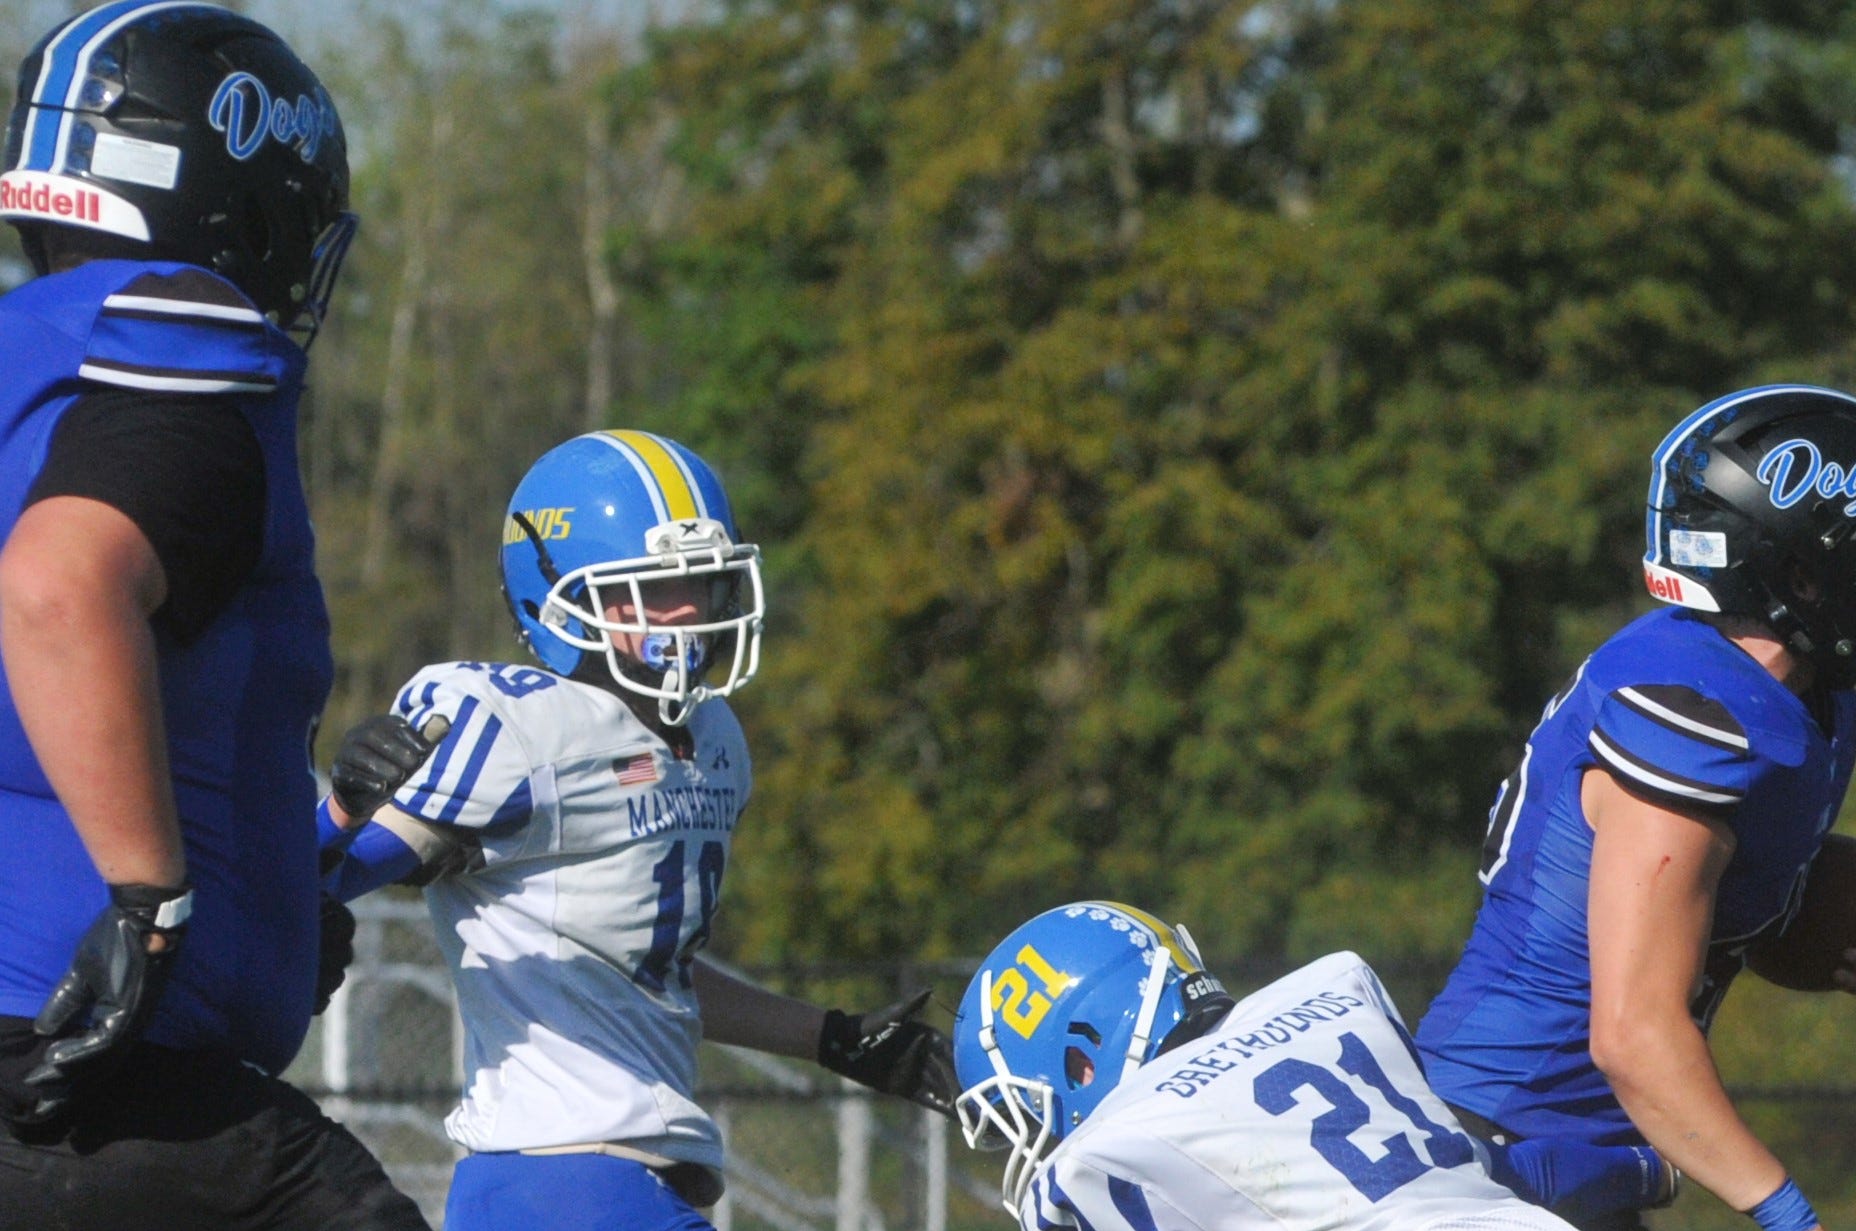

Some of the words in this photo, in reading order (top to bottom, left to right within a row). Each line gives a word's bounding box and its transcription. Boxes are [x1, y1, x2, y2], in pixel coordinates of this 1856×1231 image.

[208, 71, 336, 164] Dogs
[0, 180, 100, 223] Riddell
[990, 943, 1072, 1040] 21
[1253, 1031, 1474, 1204] 21
